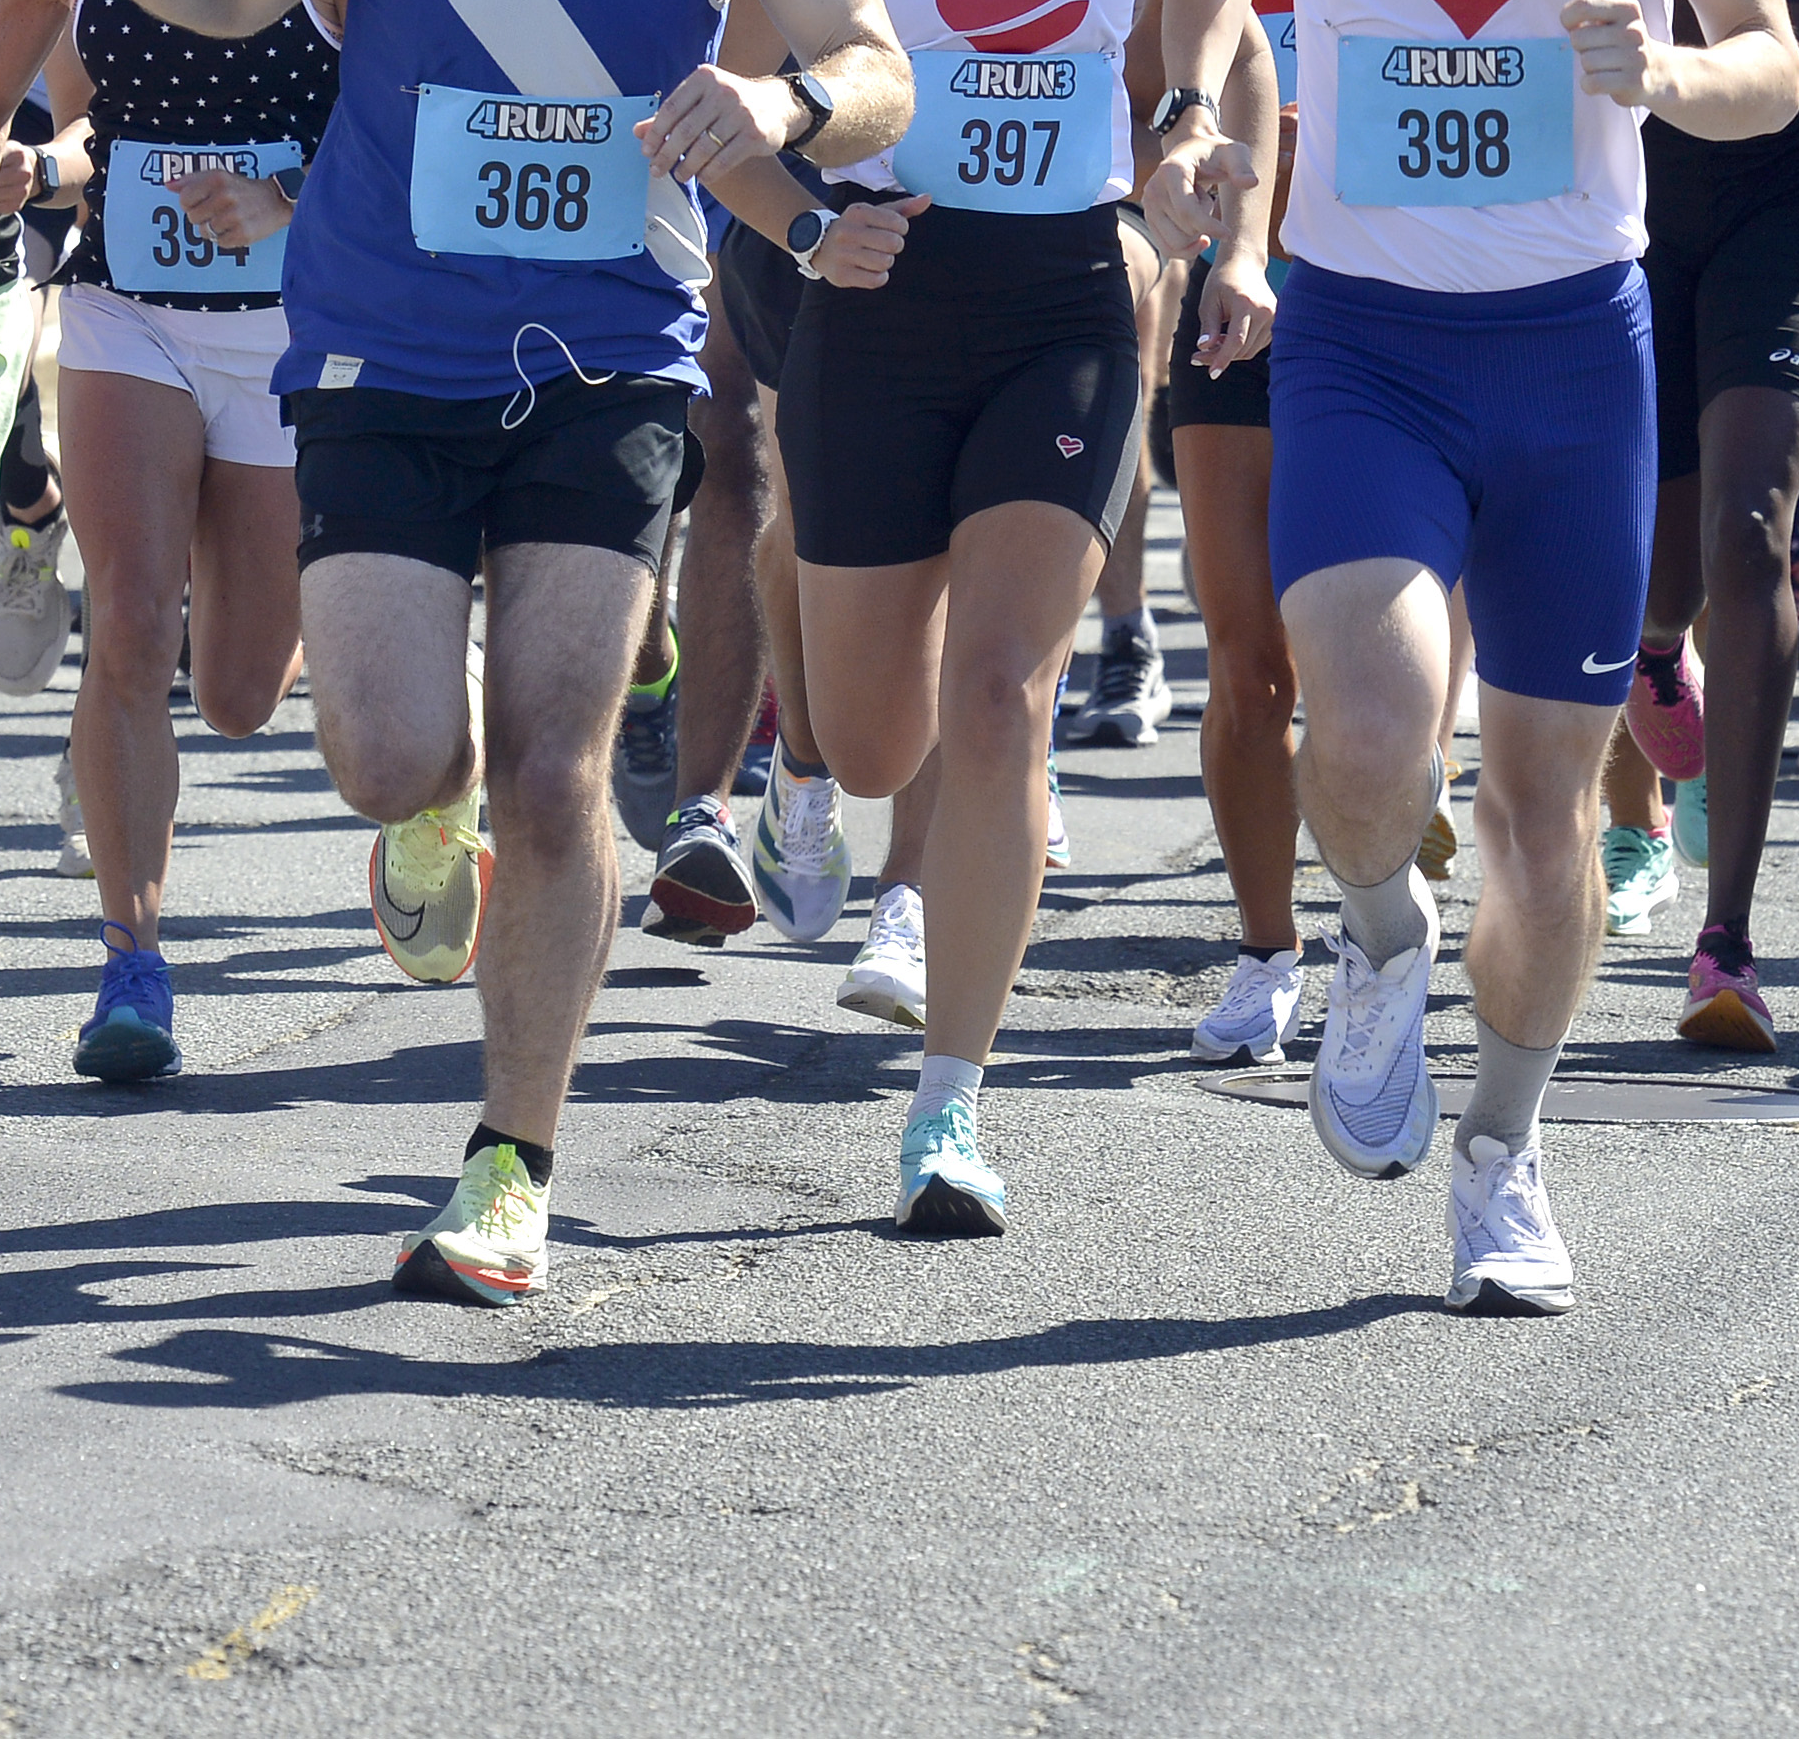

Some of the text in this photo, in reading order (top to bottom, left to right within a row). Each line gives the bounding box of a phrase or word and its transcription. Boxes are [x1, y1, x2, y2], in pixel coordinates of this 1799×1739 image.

[950, 58, 1076, 99] 4RUN3
[1382, 44, 1524, 89] 4RUN3
[467, 100, 613, 144] 4RUN3
[1397, 107, 1511, 179] 398
[957, 118, 1061, 187] 397
[475, 160, 591, 232] 368
